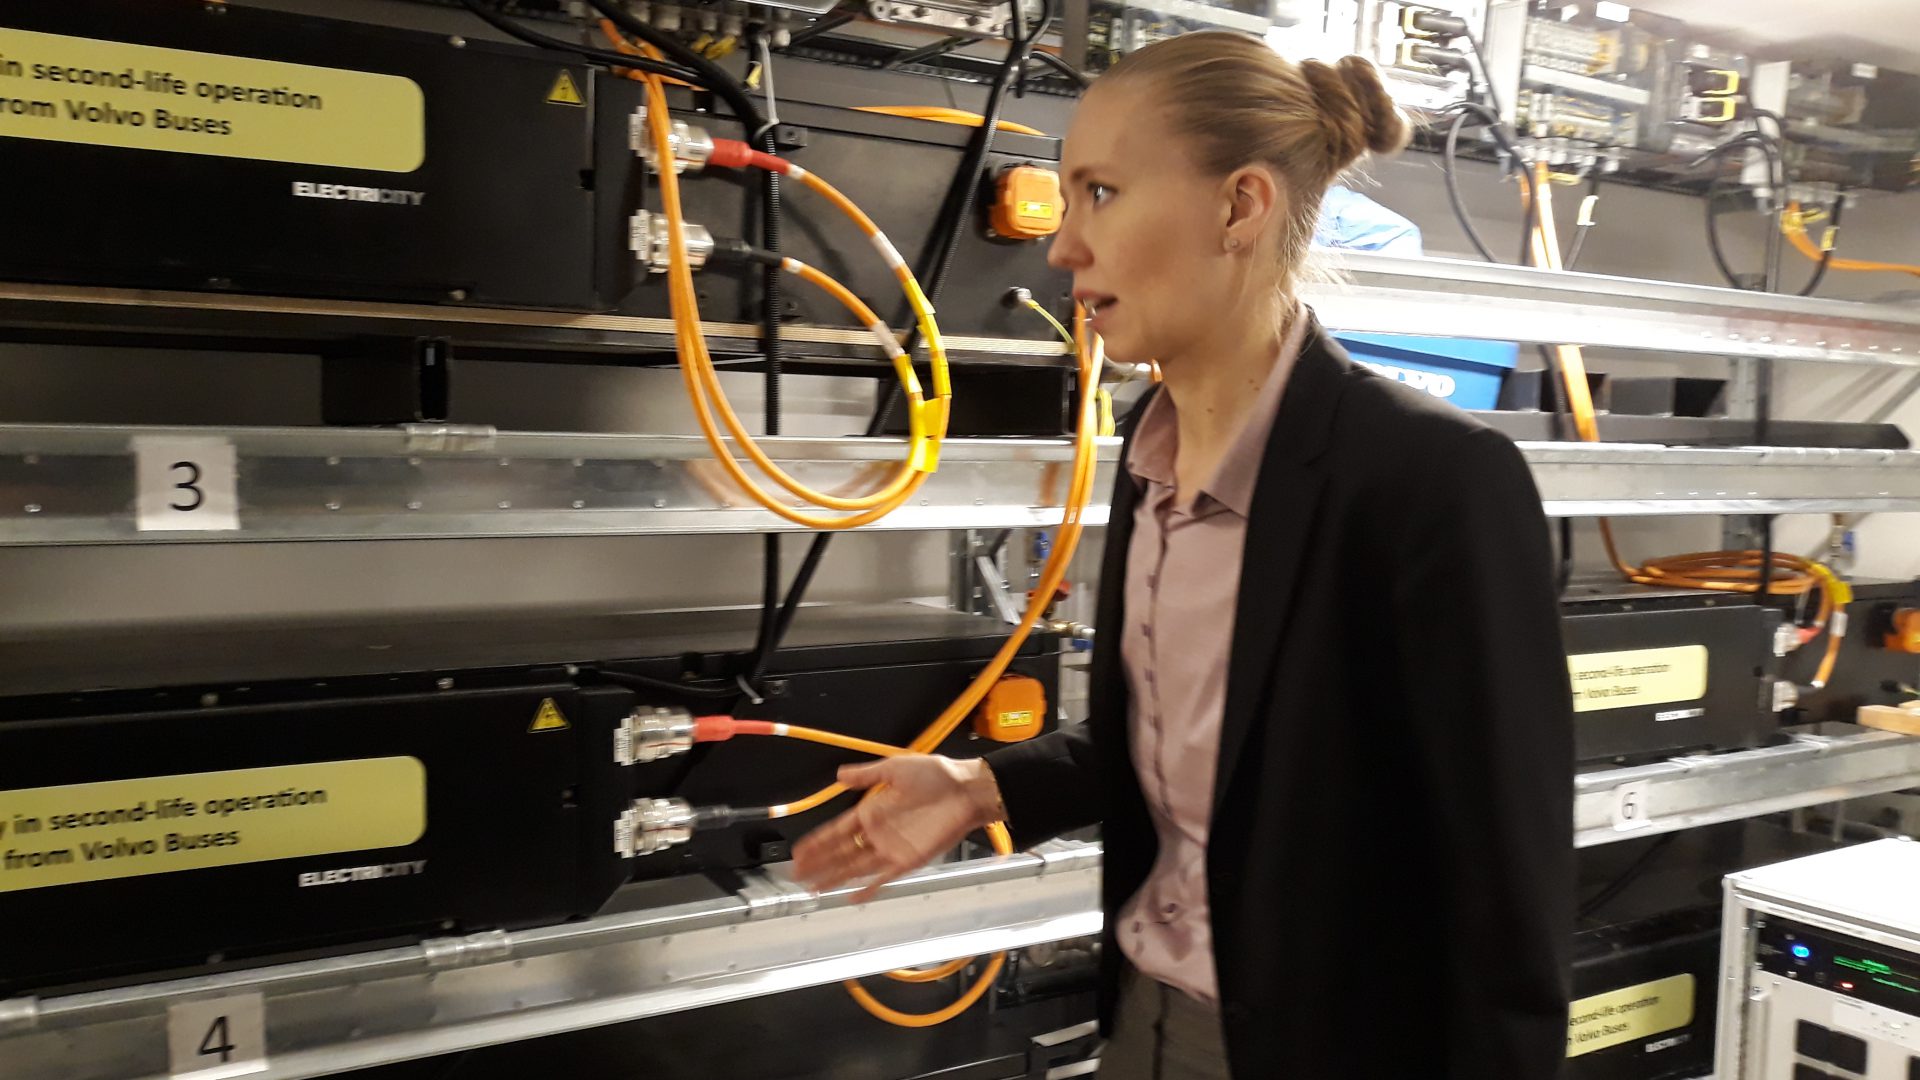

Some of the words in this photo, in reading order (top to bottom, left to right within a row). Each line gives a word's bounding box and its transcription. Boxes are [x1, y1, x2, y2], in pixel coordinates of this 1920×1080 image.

[32, 63, 187, 95] second-life
[196, 81, 323, 110] operation
[63, 100, 145, 126] Volvo
[154, 108, 232, 135] Buses
[168, 461, 205, 511] 3
[13, 814, 42, 834] in
[49, 797, 198, 831] second-life
[204, 787, 328, 817] operation
[1622, 791, 1639, 820] 6
[4, 849, 74, 870] from
[79, 837, 158, 861] Volvo
[165, 831, 241, 852] Buses
[198, 1016, 236, 1062] 4
